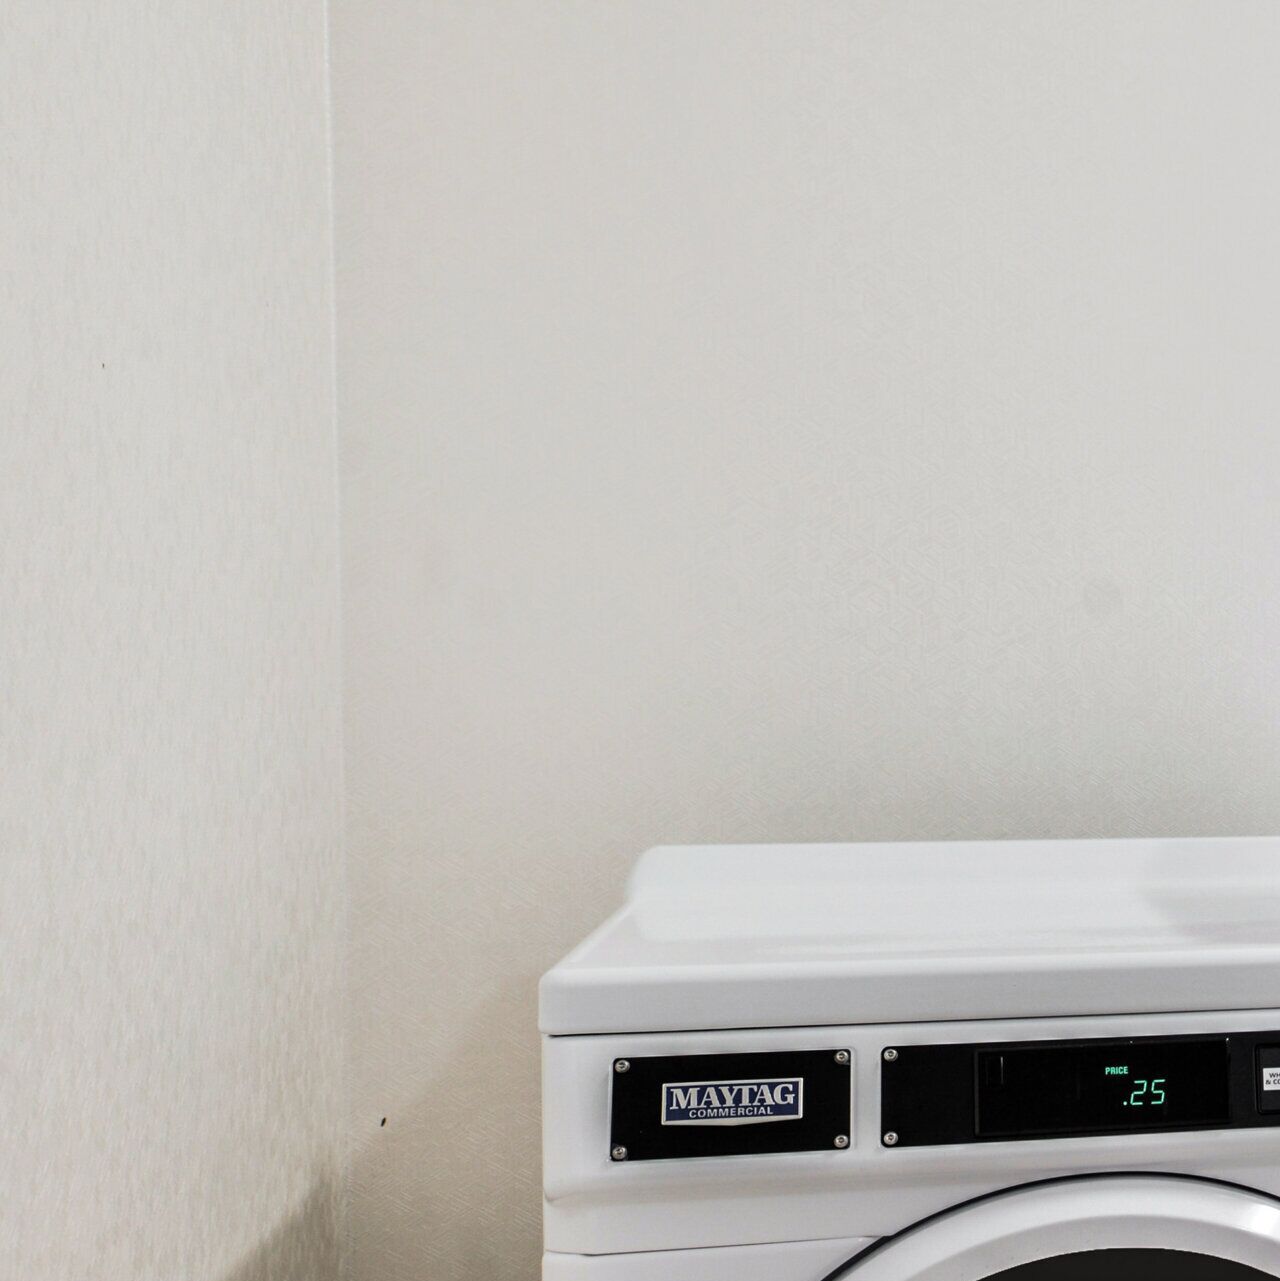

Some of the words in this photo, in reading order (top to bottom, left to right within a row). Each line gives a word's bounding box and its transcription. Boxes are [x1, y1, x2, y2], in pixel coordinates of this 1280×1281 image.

[1105, 1066, 1128, 1075] PRICE
[669, 1083, 795, 1110] MAYTAG
[1123, 1079, 1165, 1105] .25
[689, 1106, 774, 1118] COMMERCIAL
